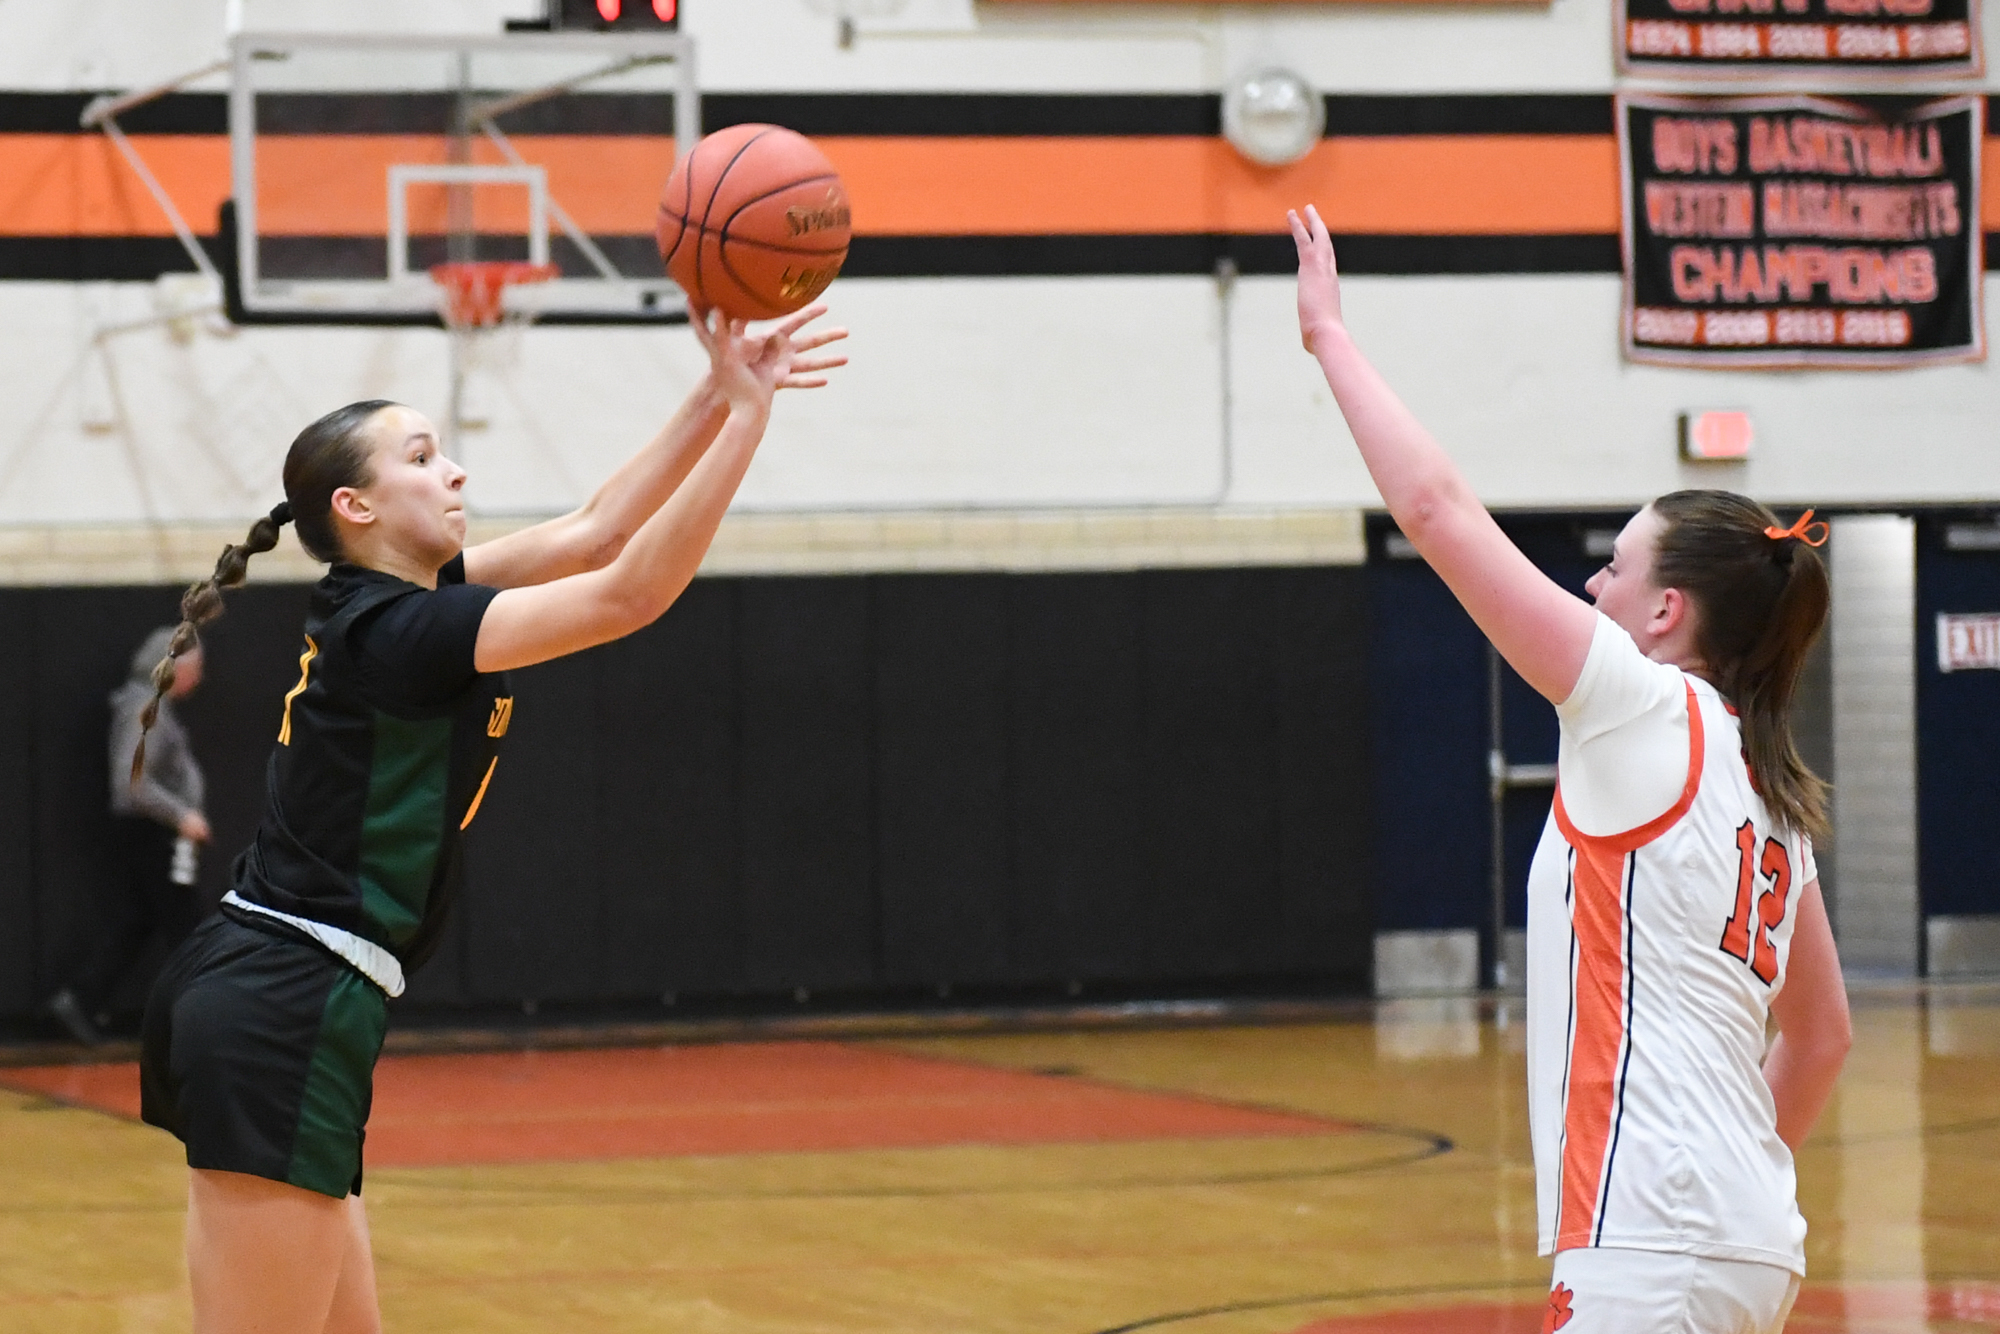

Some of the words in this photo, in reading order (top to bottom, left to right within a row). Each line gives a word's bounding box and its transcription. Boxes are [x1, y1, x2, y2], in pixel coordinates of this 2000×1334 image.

[1653, 116, 1738, 174] BOYS
[1749, 117, 1945, 178] BASKETBALL
[1645, 180, 1753, 239] WESTERN
[1671, 246, 1938, 303] CHAMPIONS
[1719, 817, 1792, 988] 12
